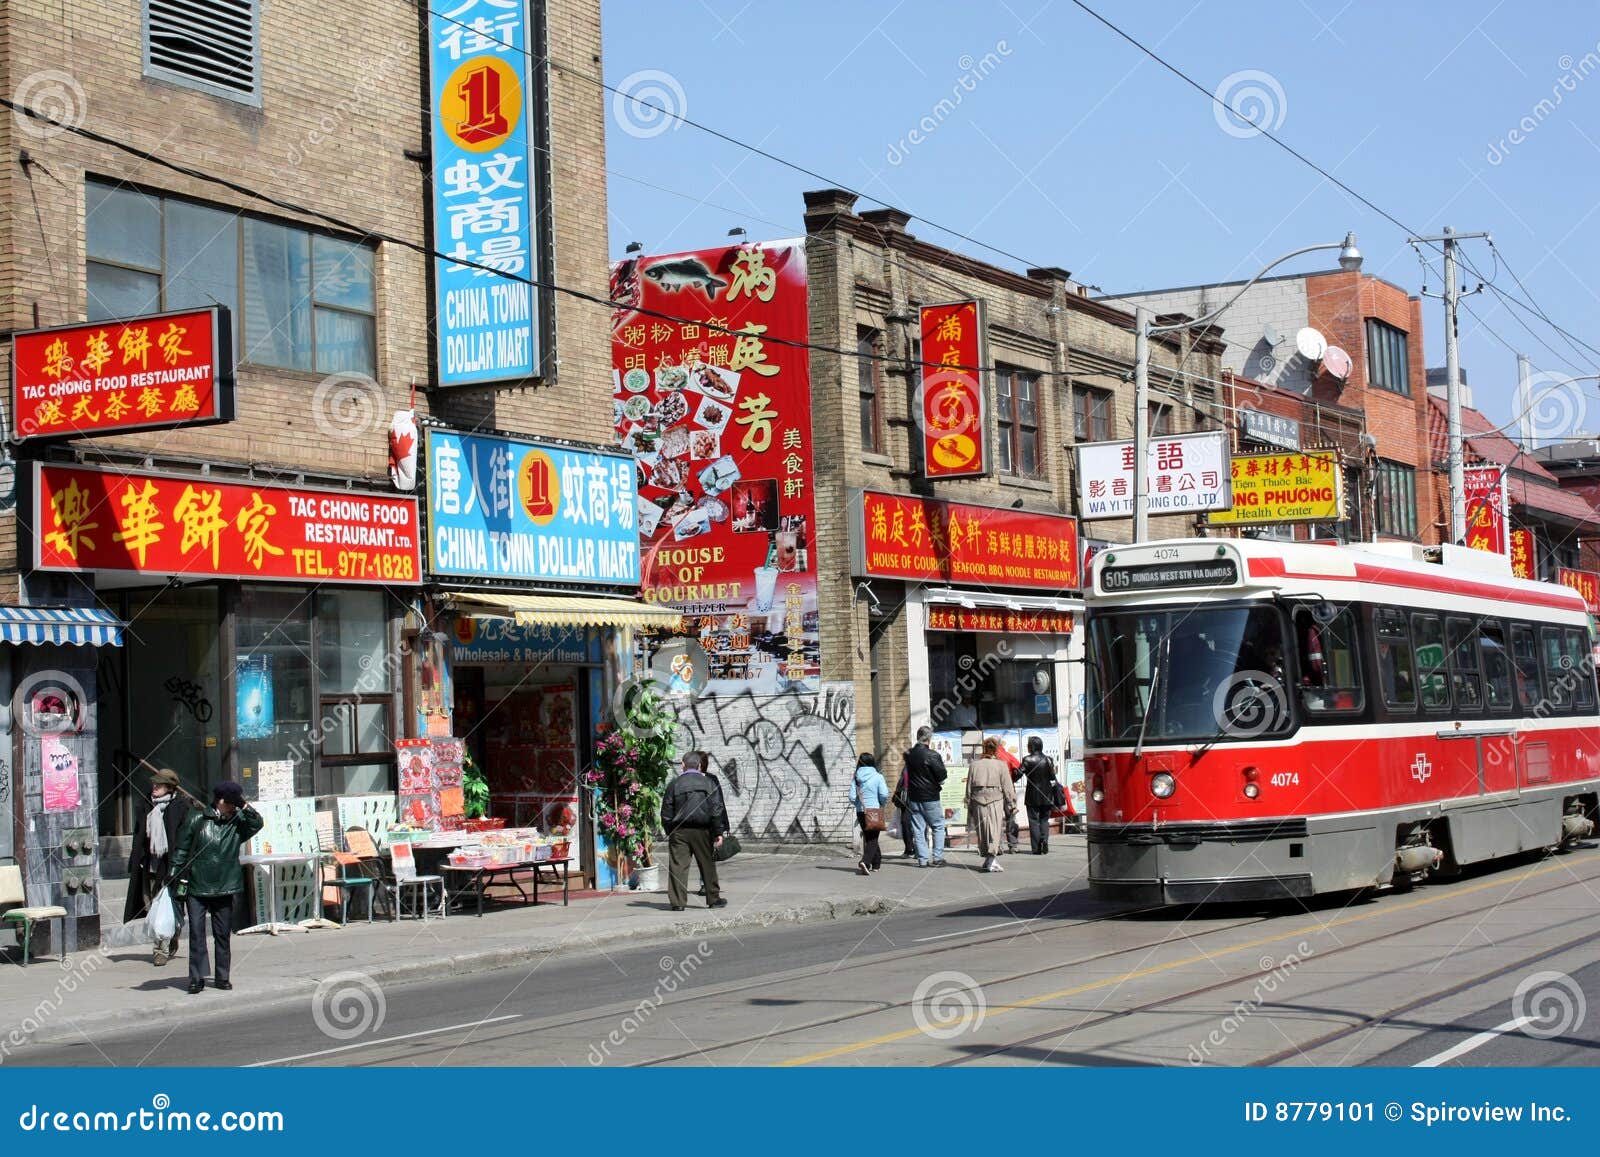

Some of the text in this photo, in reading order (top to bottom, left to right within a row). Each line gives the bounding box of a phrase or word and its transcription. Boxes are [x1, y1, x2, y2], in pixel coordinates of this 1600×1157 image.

[443, 153, 527, 279] 蚊商場
[446, 282, 529, 329] CHINA TOWN
[42, 323, 193, 378] 樂華餅家
[447, 326, 529, 374] DOLLAR MART
[22, 366, 210, 400] TAC CHONG FOOD RESTAURANT
[38, 384, 200, 427] 港式茶餐廳
[782, 428, 804, 499] 美食軒
[434, 439, 515, 519] 唐人街
[562, 453, 633, 530] 蚊商場
[1088, 471, 1218, 498] 影音書公司
[288, 496, 409, 525] TAC CHONG FOOD
[1088, 501, 1106, 514] WA
[1110, 499, 1121, 512] YI
[1197, 493, 1221, 506] LTD.
[1232, 492, 1258, 507] NG
[1236, 505, 1312, 519] Health Center
[44, 477, 285, 570] 樂華餅家
[305, 522, 412, 549] RESTAURANT LTD.
[292, 549, 413, 579] TEL. 977-1828
[436, 526, 635, 579] CHINA TOWN DOLLAR MART
[658, 547, 725, 566] HOUSE
[873, 551, 899, 569] HOUSE
[901, 554, 911, 569] OF
[914, 555, 950, 573] GOURMET
[1005, 566, 1031, 579] NOODLE
[1033, 568, 1072, 582] RESTAURANT
[1154, 549, 1180, 560] 4074
[679, 567, 704, 583] OF
[1105, 567, 1232, 588] 505 DUNDAS WEST STN VIA DUNDAS
[643, 583, 742, 604] GOURMET
[453, 647, 585, 662] Wholesale & Retail Items
[1270, 773, 1299, 787] 4074
